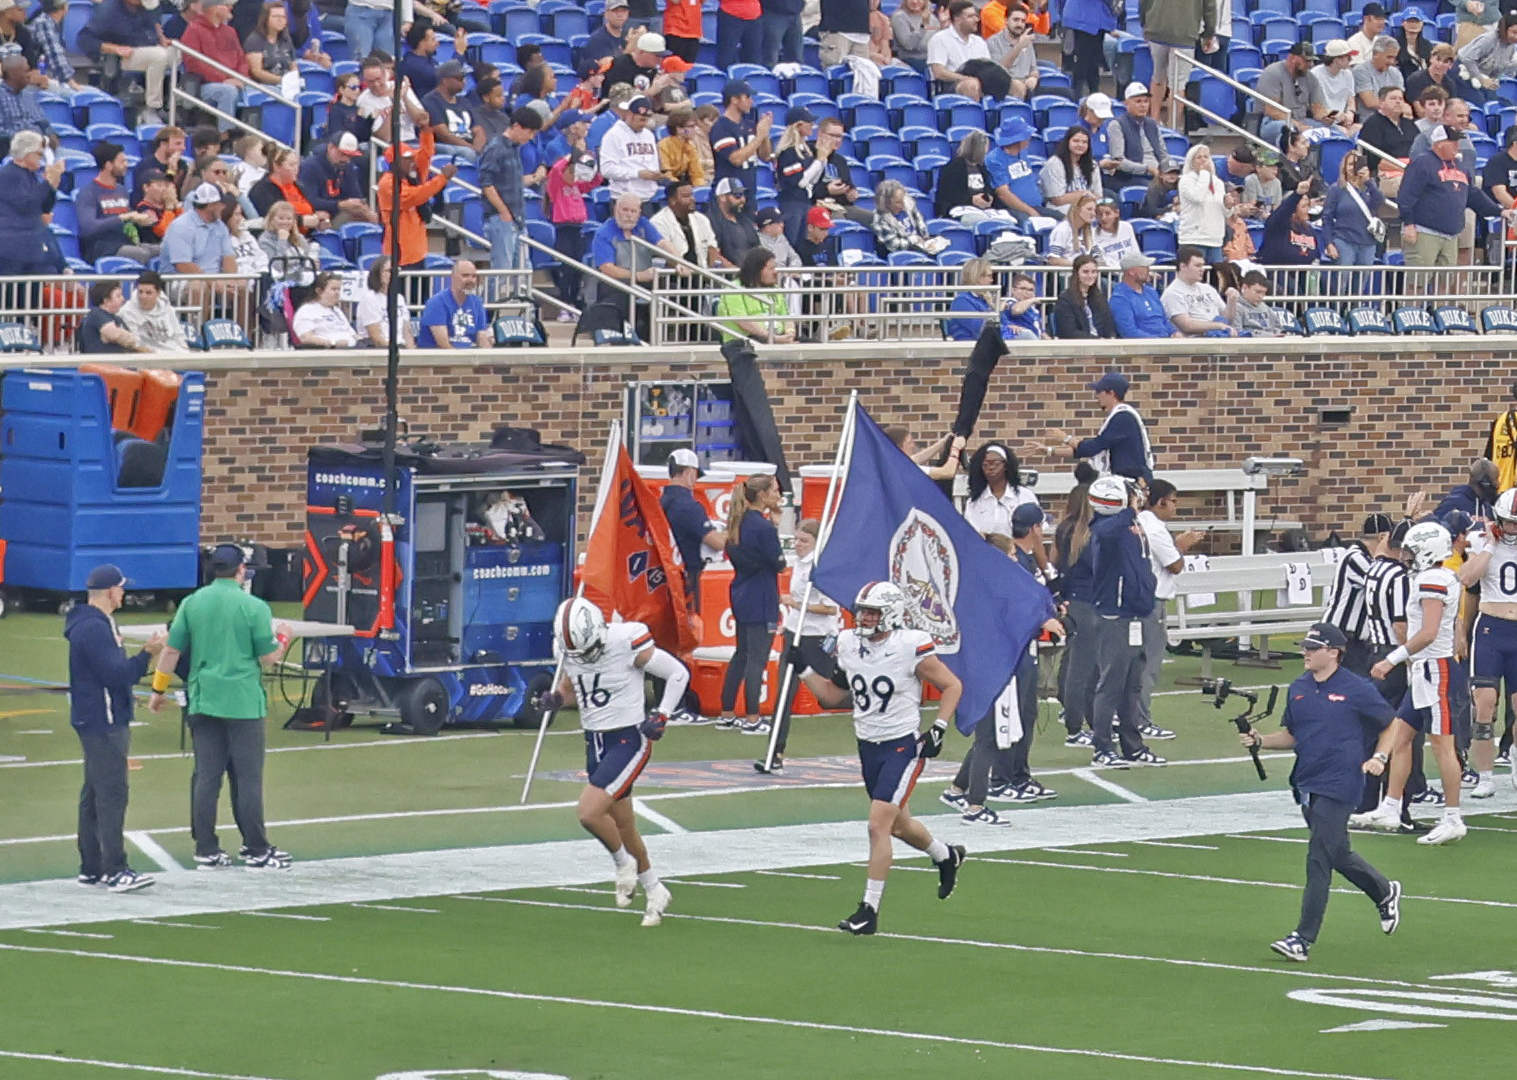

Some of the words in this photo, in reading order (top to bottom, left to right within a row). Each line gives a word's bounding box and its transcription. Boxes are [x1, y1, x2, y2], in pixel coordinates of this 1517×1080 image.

[1310, 309, 1342, 326] DUKE
[1354, 309, 1387, 326] DUKE
[1397, 309, 1432, 326] DUKE
[1440, 309, 1468, 326] DUKE
[1490, 309, 1517, 326] DUKE
[500, 321, 536, 337] DUKE
[315, 471, 400, 490] coachcomm.c
[472, 564, 550, 580] coachcomm.com
[577, 673, 611, 709] 16
[851, 673, 895, 714] 89
